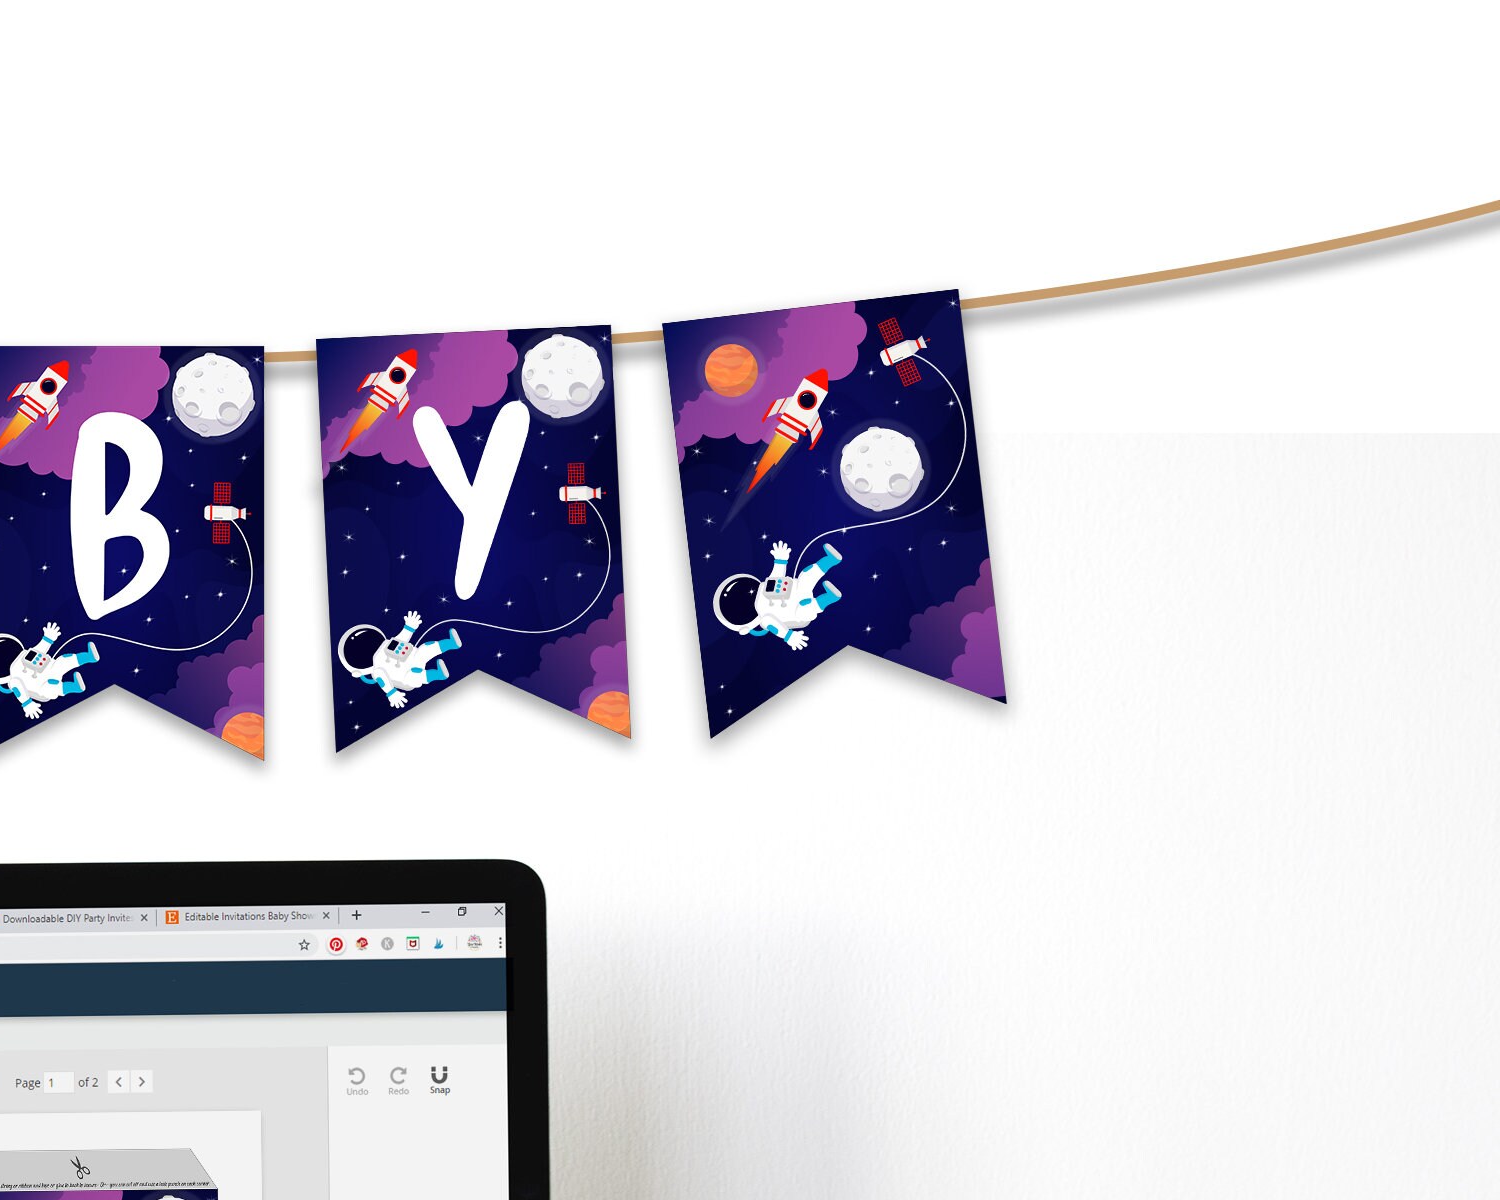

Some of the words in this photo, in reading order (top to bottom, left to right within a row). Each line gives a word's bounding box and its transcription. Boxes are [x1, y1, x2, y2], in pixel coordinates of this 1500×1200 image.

[71, 412, 169, 620] B
[413, 401, 530, 600] Y
[3, 914, 64, 924] Downloadable
[66, 913, 81, 923] DIY
[84, 913, 105, 925] Party
[185, 912, 219, 921] Editable
[222, 912, 265, 921] Invitations
[268, 911, 289, 922] Baby
[15, 1078, 41, 1091] Page
[78, 1077, 90, 1088] of
[92, 1077, 99, 1088] 2
[346, 1084, 369, 1096] Undo
[388, 1084, 410, 1095] Redo
[430, 1083, 451, 1096] Snap
